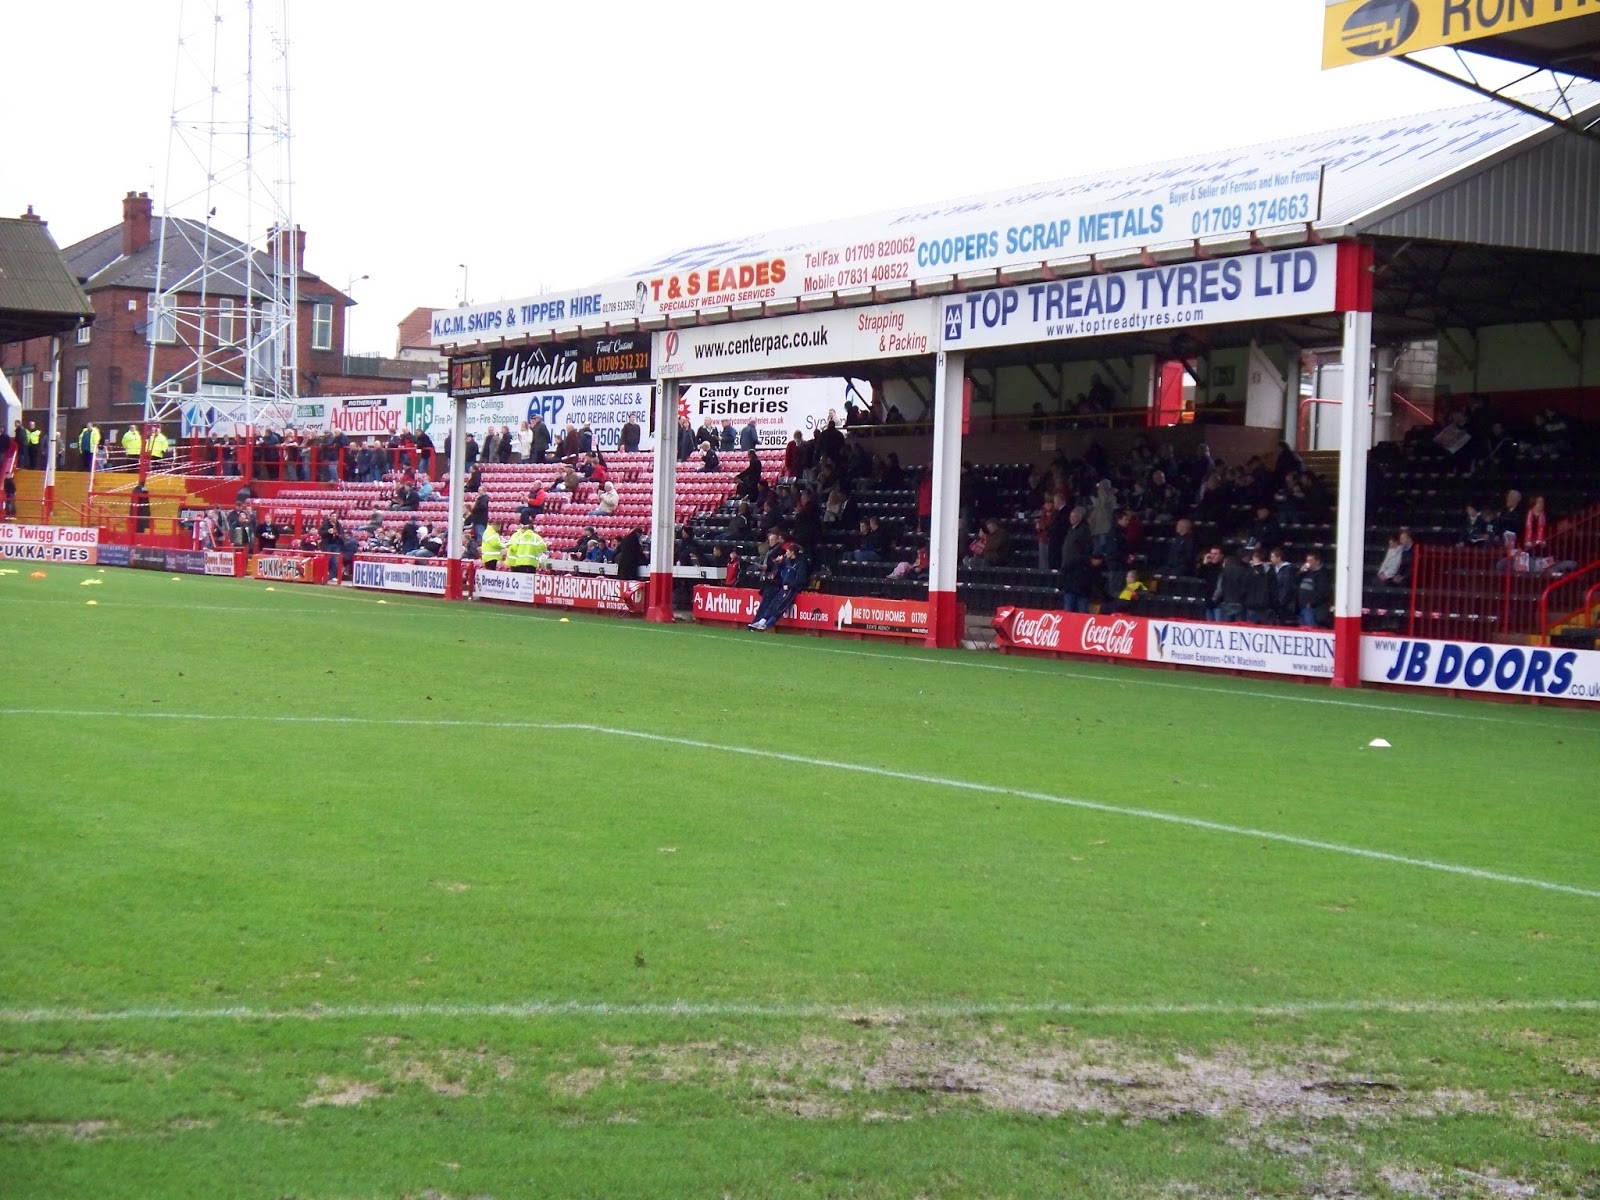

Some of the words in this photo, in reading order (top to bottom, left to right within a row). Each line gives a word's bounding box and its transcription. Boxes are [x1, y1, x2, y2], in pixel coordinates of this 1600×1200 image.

[1169, 189, 1189, 206] Buyer
[1190, 188, 1196, 201] &
[1198, 185, 1219, 200] Seller
[1220, 182, 1228, 196] of
[1229, 178, 1257, 193] Ferrous
[1259, 174, 1273, 189] and
[1274, 173, 1289, 186] Non
[1291, 169, 1320, 184] Ferrous
[1192, 205, 1242, 235] 01709
[1247, 193, 1309, 227] 374663
[917, 231, 998, 268] COOPERS
[1006, 218, 1071, 254] SCRAP
[1078, 204, 1164, 244] METALS
[805, 250, 839, 269] Tel/Fax
[845, 242, 875, 262] 01709
[877, 236, 915, 257] 820062
[650, 279, 663, 301] T
[667, 275, 681, 298] &
[687, 271, 701, 296] S
[707, 258, 786, 292] EADES
[804, 273, 835, 292] Mobile
[837, 267, 869, 287] 07831
[871, 261, 909, 282] 408522
[966, 289, 1019, 329] TOP
[1028, 275, 1126, 321] TREAD
[1136, 258, 1242, 310] TYRES
[1255, 249, 1318, 297] LTD
[602, 302, 617, 314] 01709
[659, 299, 700, 312] SPECIALIST
[701, 294, 736, 308] WELDING
[738, 287, 776, 302] SERVICES
[433, 318, 466, 337] K.C.M.
[468, 310, 502, 331] SKIPS
[507, 308, 516, 325] &
[521, 300, 565, 324] TIPPER
[570, 294, 602, 317] HIRE
[858, 311, 905, 336] Strapping
[1046, 309, 1204, 336] www.toptreadtyres.com
[695, 325, 828, 359] www.centerpac.co.uk
[879, 336, 886, 352] &
[889, 331, 927, 354] Packing
[496, 353, 578, 391] Himalia
[583, 356, 594, 374] Tel.
[597, 355, 619, 372] 01709
[620, 354, 633, 370] 512
[635, 352, 648, 369] 321
[348, 399, 382, 407] ROTHERHAM
[480, 400, 504, 410] Ceilings
[572, 394, 587, 406] VAN
[589, 393, 633, 406] HIRE/SALES
[635, 392, 642, 405] &
[699, 386, 739, 401] Candy
[744, 385, 790, 397] Corner
[330, 405, 401, 431] Advertiser
[526, 395, 564, 425] AFP
[566, 412, 585, 424] AUTO
[588, 410, 615, 424] REPAIR
[699, 398, 789, 415] Fisheries
[435, 415, 445, 424] Fire
[480, 414, 491, 424] Fire
[492, 414, 519, 425] Stopping
[18, 526, 54, 543] Twigg
[58, 528, 96, 543] Foods
[354, 562, 385, 587] DEMEX
[412, 570, 427, 587] 01709
[482, 575, 504, 590] Brearley
[512, 578, 519, 589] Co
[534, 575, 552, 595] ECD
[553, 576, 621, 602] FABRICATIONS
[705, 592, 742, 614] Arthur
[853, 608, 861, 619] ME
[863, 608, 870, 620] TO
[871, 609, 884, 621] YOU
[885, 610, 906, 622] HOMES
[911, 612, 927, 624] 01709
[1011, 611, 1063, 648] Coca-Cola
[1081, 616, 1137, 655] Coca-Cola
[1172, 626, 1224, 650] ROOTA
[1229, 631, 1335, 659] ENGINEERIN
[1171, 651, 1194, 662] Precision
[1237, 656, 1266, 668] Machinists
[1293, 662, 1335, 674] www.roota.c
[1386, 641, 1431, 683] JB
[1435, 644, 1578, 695] DOORS
